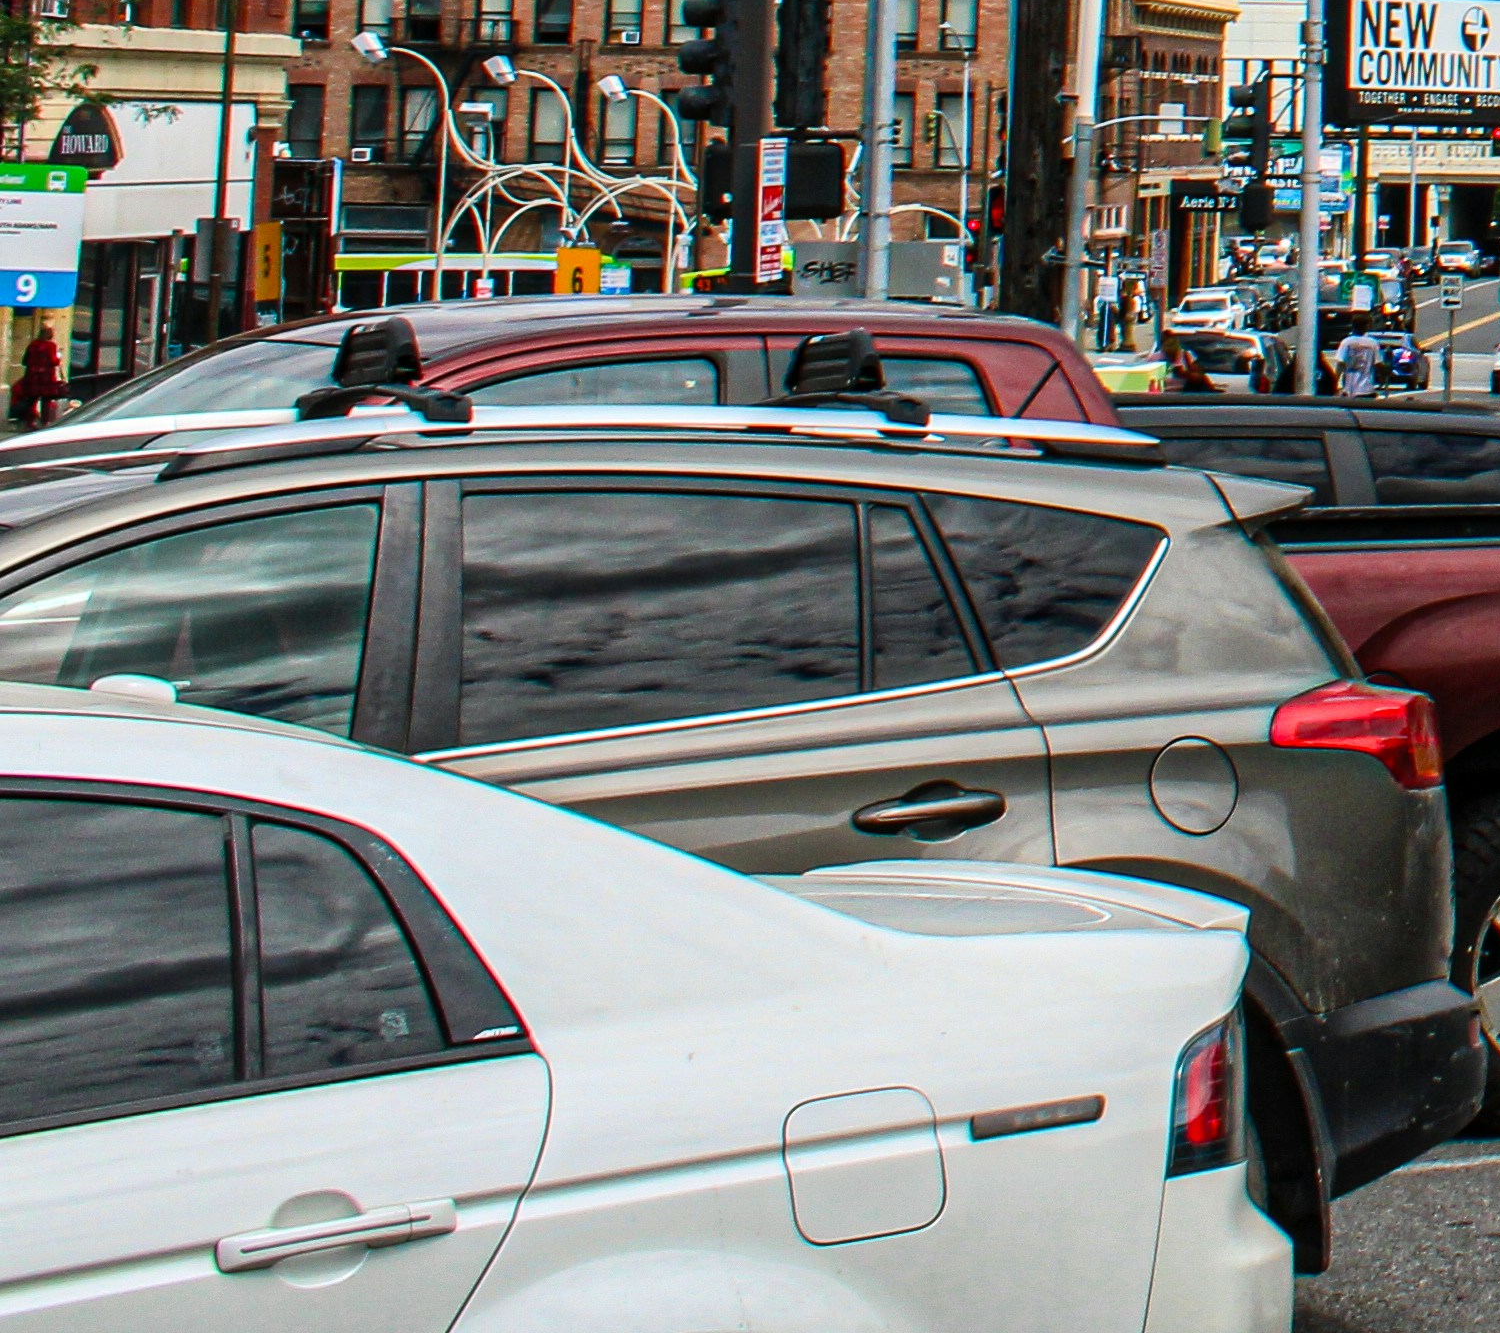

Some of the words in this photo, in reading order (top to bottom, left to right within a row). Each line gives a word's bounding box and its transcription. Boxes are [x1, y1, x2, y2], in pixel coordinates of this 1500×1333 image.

[1360, 0, 1439, 49] NEW
[1358, 91, 1406, 105] TOGETHER
[1423, 93, 1459, 106] ENGAGE
[61, 133, 109, 155] HOWARD
[16, 274, 38, 303] 9
